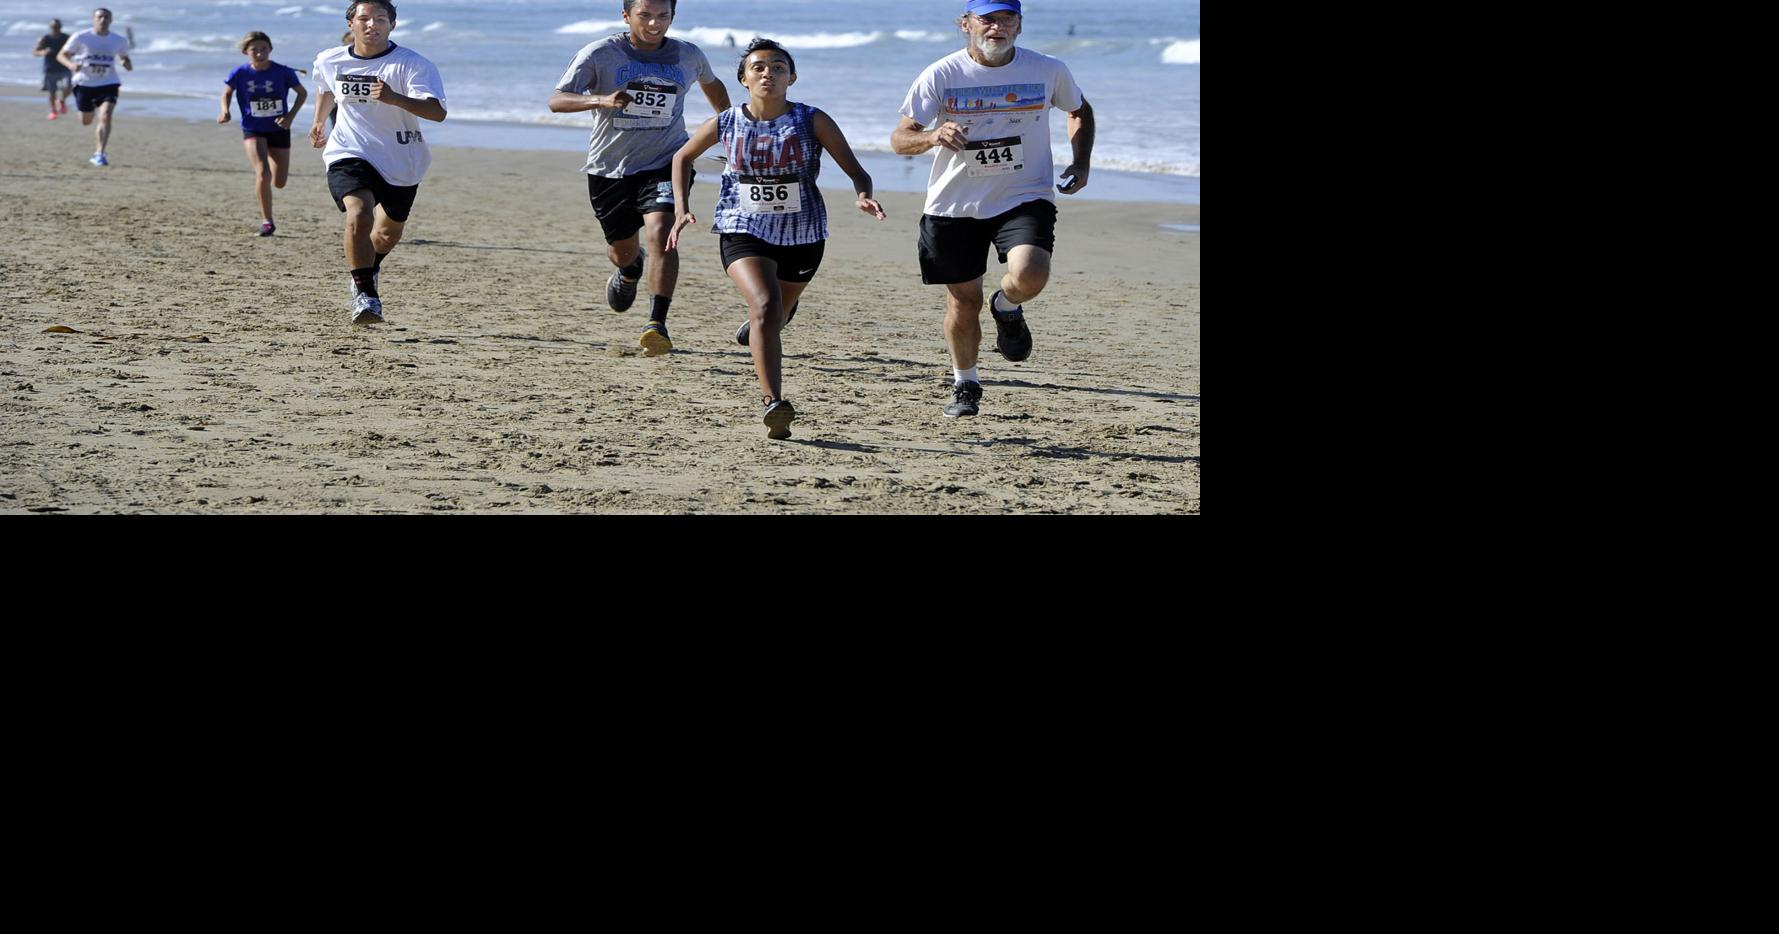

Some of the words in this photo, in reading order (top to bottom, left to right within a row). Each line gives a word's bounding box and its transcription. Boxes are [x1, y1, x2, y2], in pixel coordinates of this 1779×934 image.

[341, 82, 371, 97] 845
[256, 100, 278, 111] 184
[634, 91, 667, 108] 852
[723, 134, 803, 171] USA
[975, 146, 1014, 165] 444
[750, 185, 789, 202] 856
